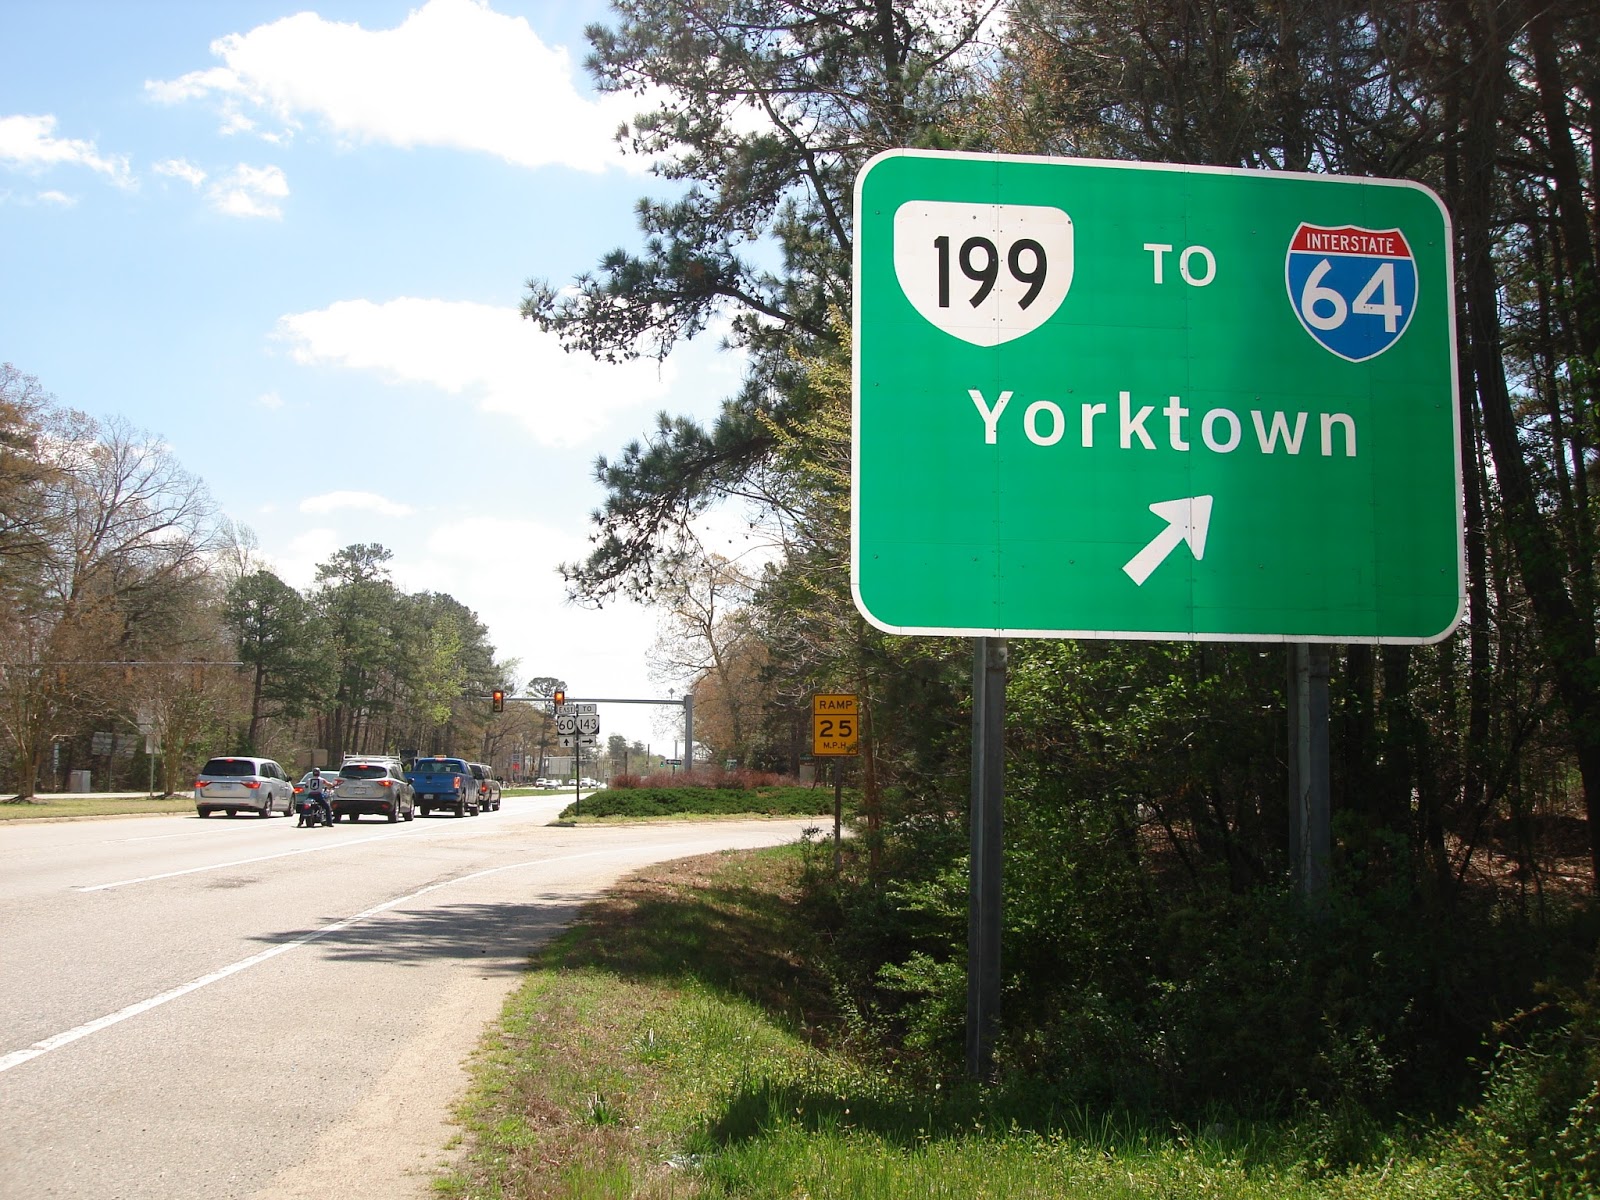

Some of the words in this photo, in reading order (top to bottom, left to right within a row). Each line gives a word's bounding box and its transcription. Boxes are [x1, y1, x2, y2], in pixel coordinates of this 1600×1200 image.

[1306, 232, 1395, 255] INTERSTATE
[934, 235, 1047, 311] 199
[1143, 243, 1217, 287] TO
[1301, 258, 1402, 333] 64
[967, 389, 1357, 457] Yorktown
[820, 700, 852, 709] RAMP
[558, 720, 574, 730] 60
[580, 718, 597, 730] 143
[819, 720, 852, 738] 25
